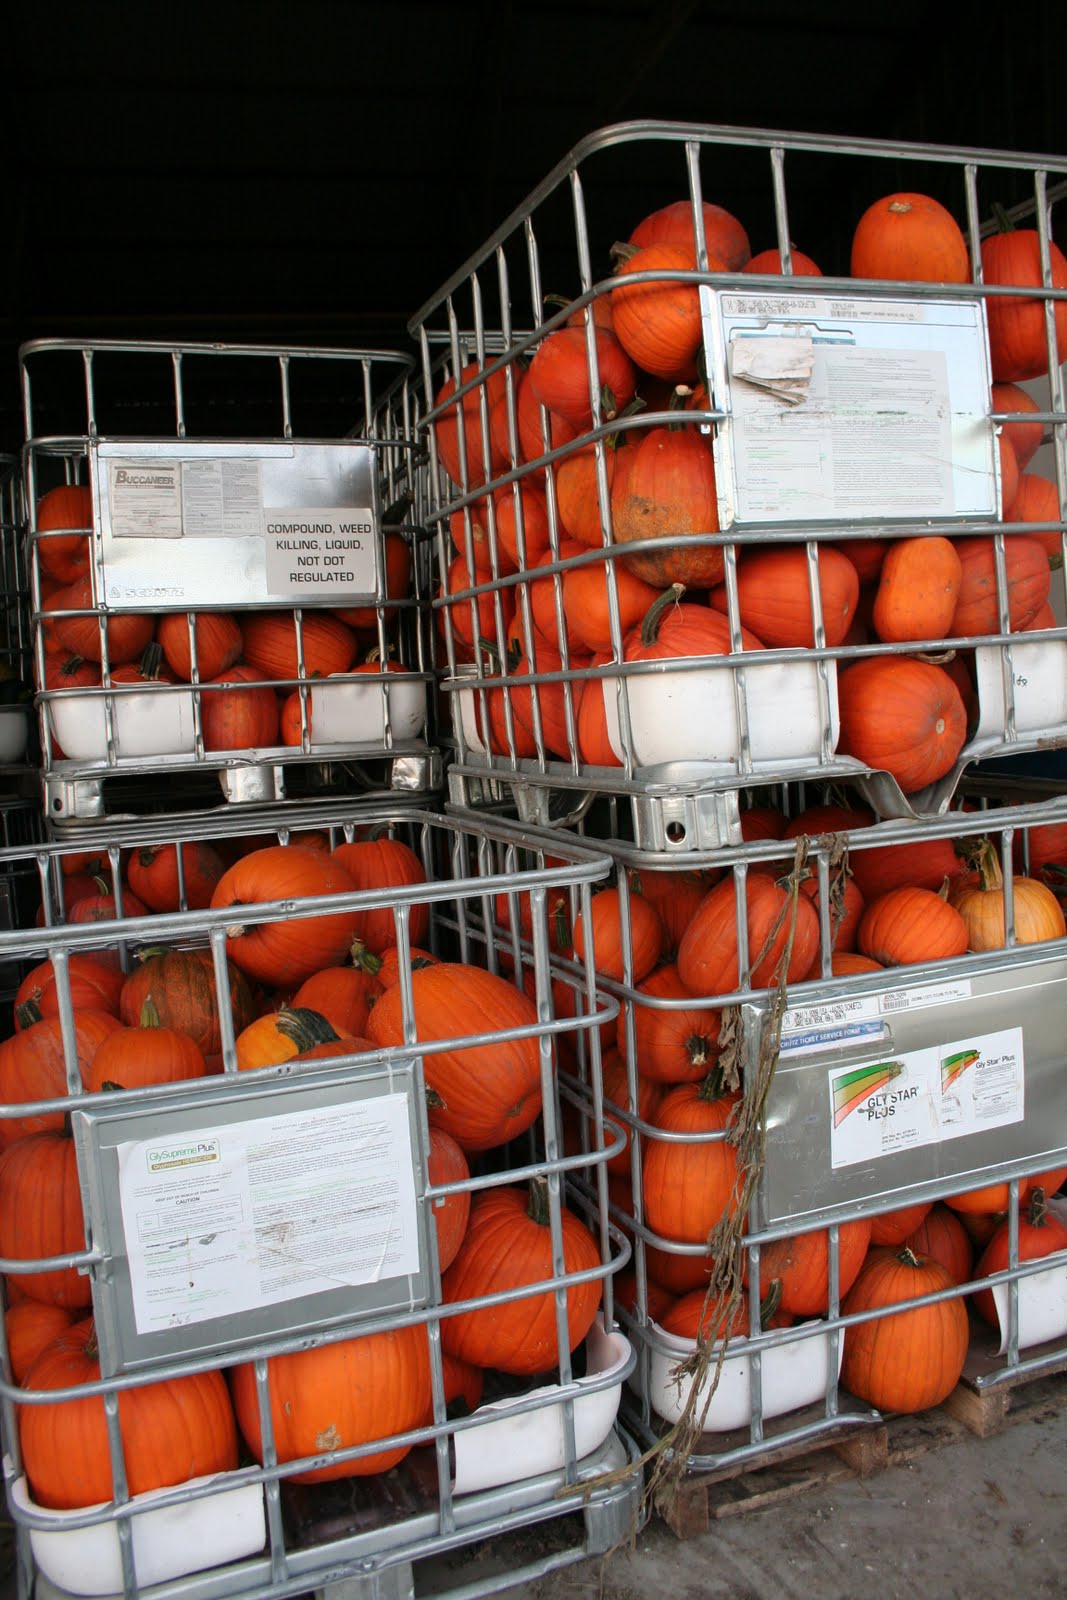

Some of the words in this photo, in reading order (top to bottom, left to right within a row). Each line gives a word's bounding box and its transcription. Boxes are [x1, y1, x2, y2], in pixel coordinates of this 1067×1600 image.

[116, 470, 174, 485] BUCCANEER
[267, 524, 336, 534] COMPOUND,
[339, 524, 372, 533] WEED
[276, 540, 322, 551] KILLING,
[325, 540, 364, 550] LIQUID,
[297, 556, 320, 566] NOT
[323, 556, 345, 565] DOT
[289, 572, 355, 582] REGULATED
[799, 1035, 819, 1044] TICKET
[819, 1030, 843, 1041] SERVICE
[867, 1095, 888, 1108] GLY
[868, 1105, 896, 1121] PLUS
[197, 1144, 215, 1152] Plus
